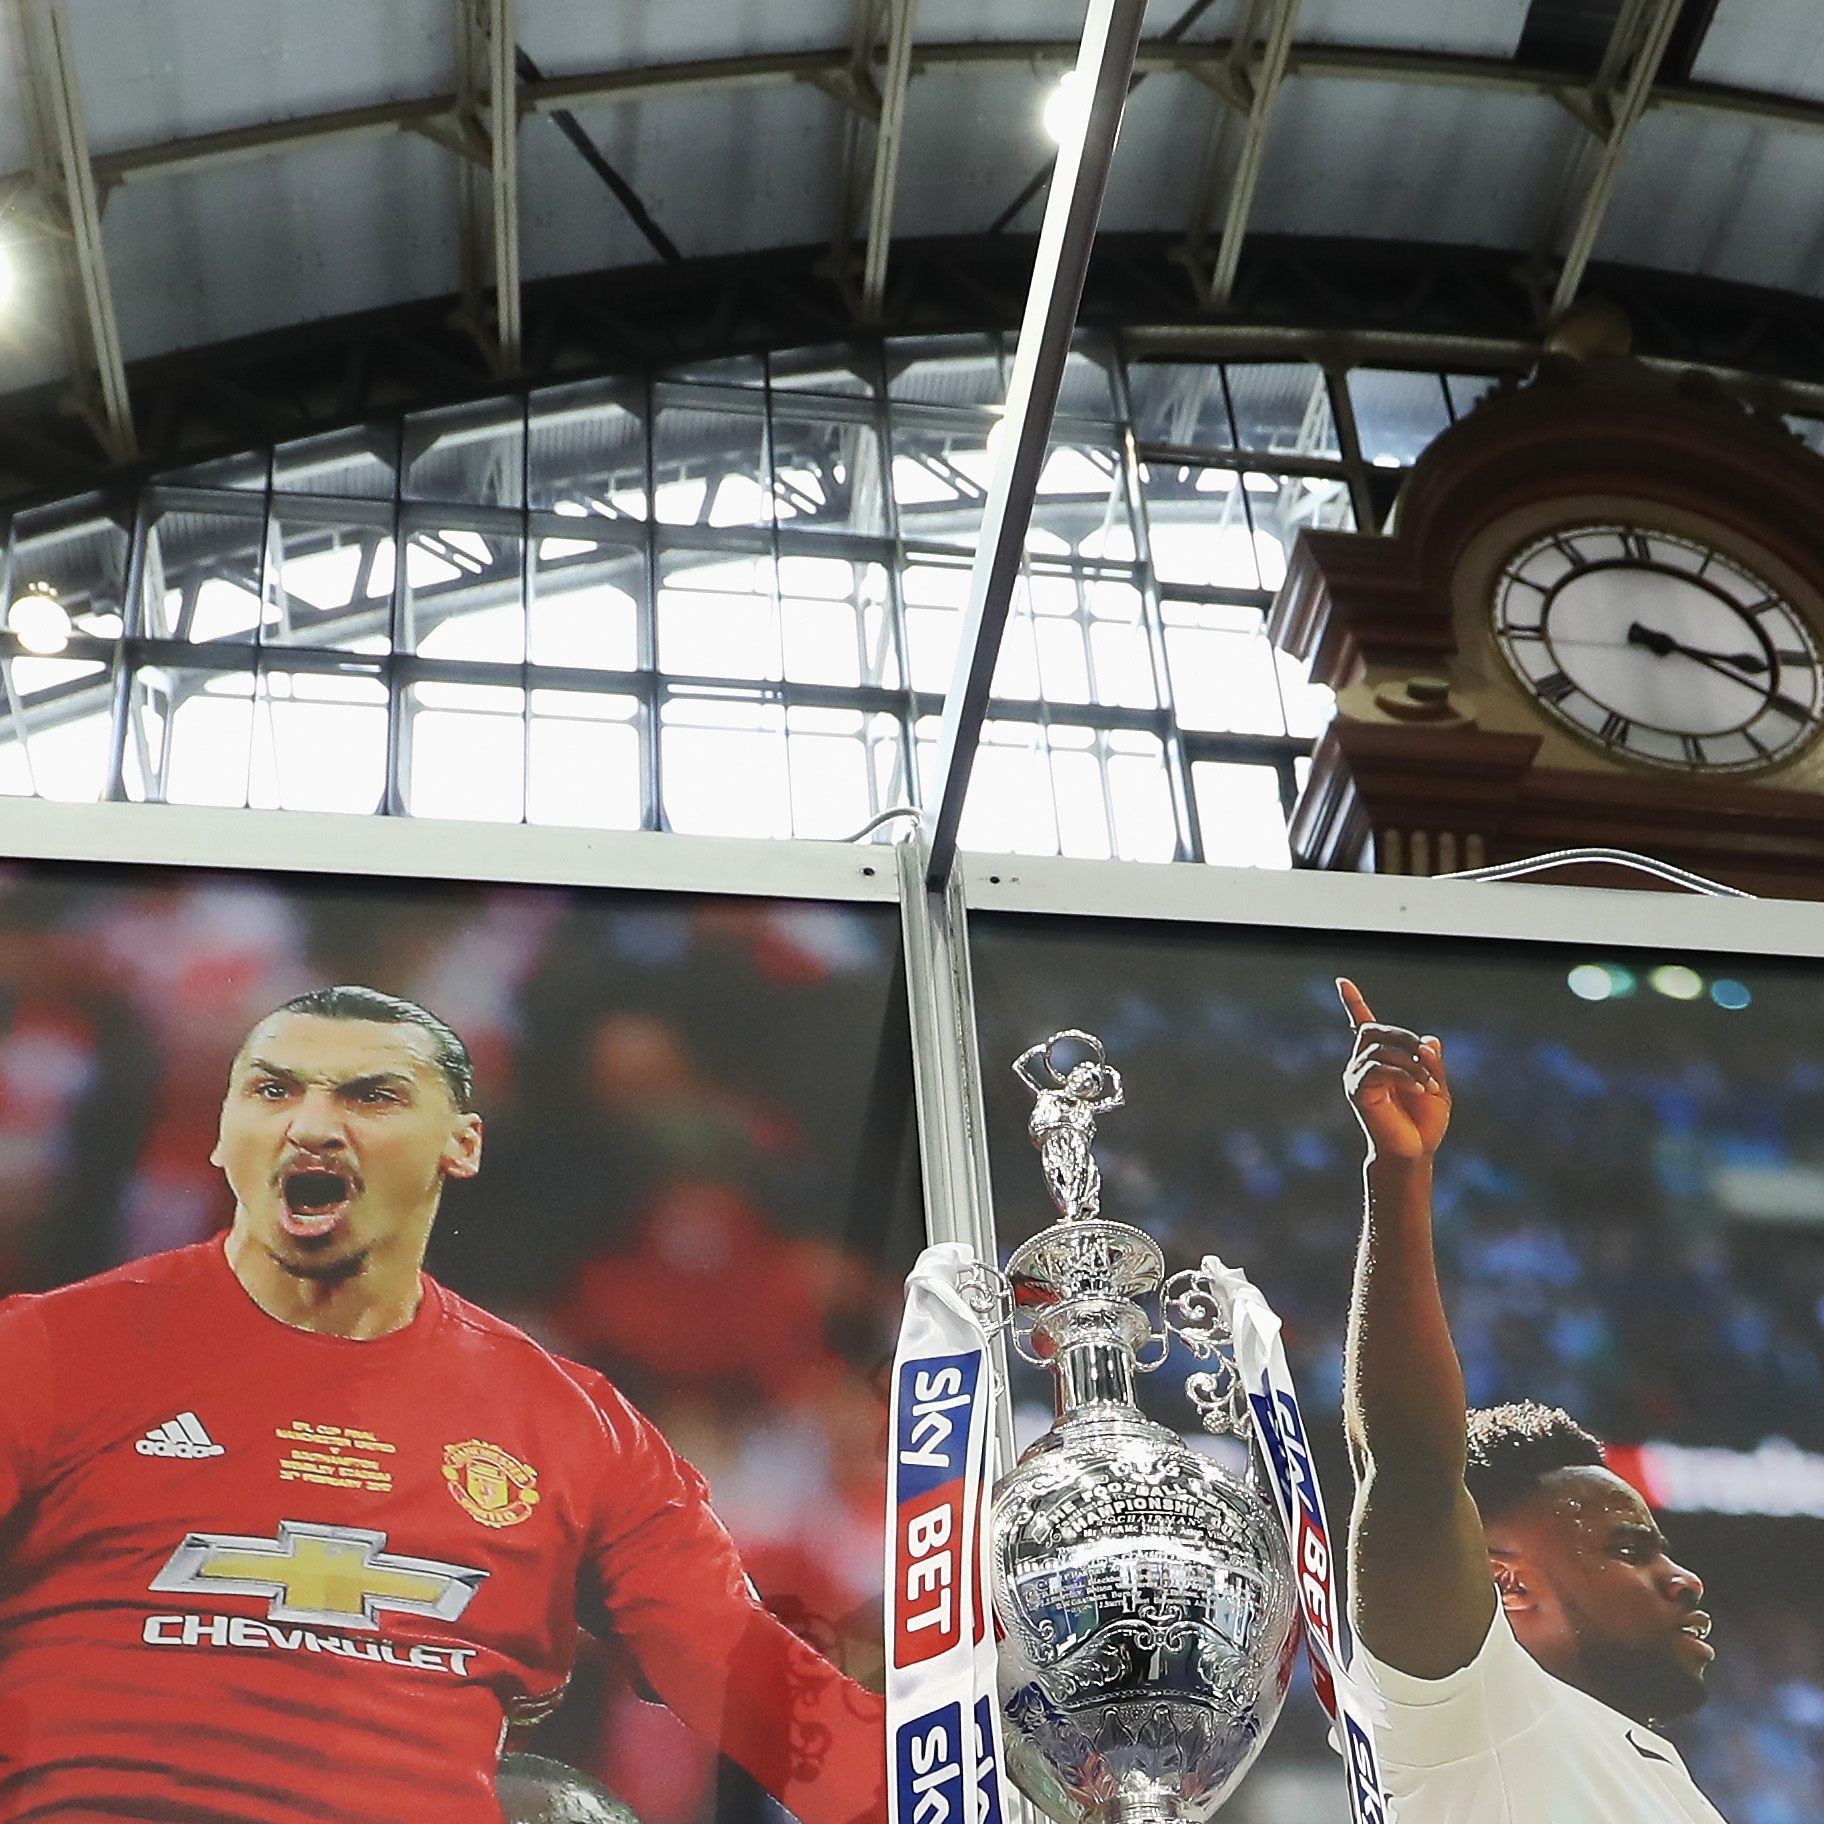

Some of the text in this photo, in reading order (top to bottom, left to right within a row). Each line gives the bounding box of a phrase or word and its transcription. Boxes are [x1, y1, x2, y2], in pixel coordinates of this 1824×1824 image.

[899, 1366, 971, 1634] sky BET
[1302, 1525, 1329, 1642] BE
[142, 1614, 477, 1677] CHEVROLET
